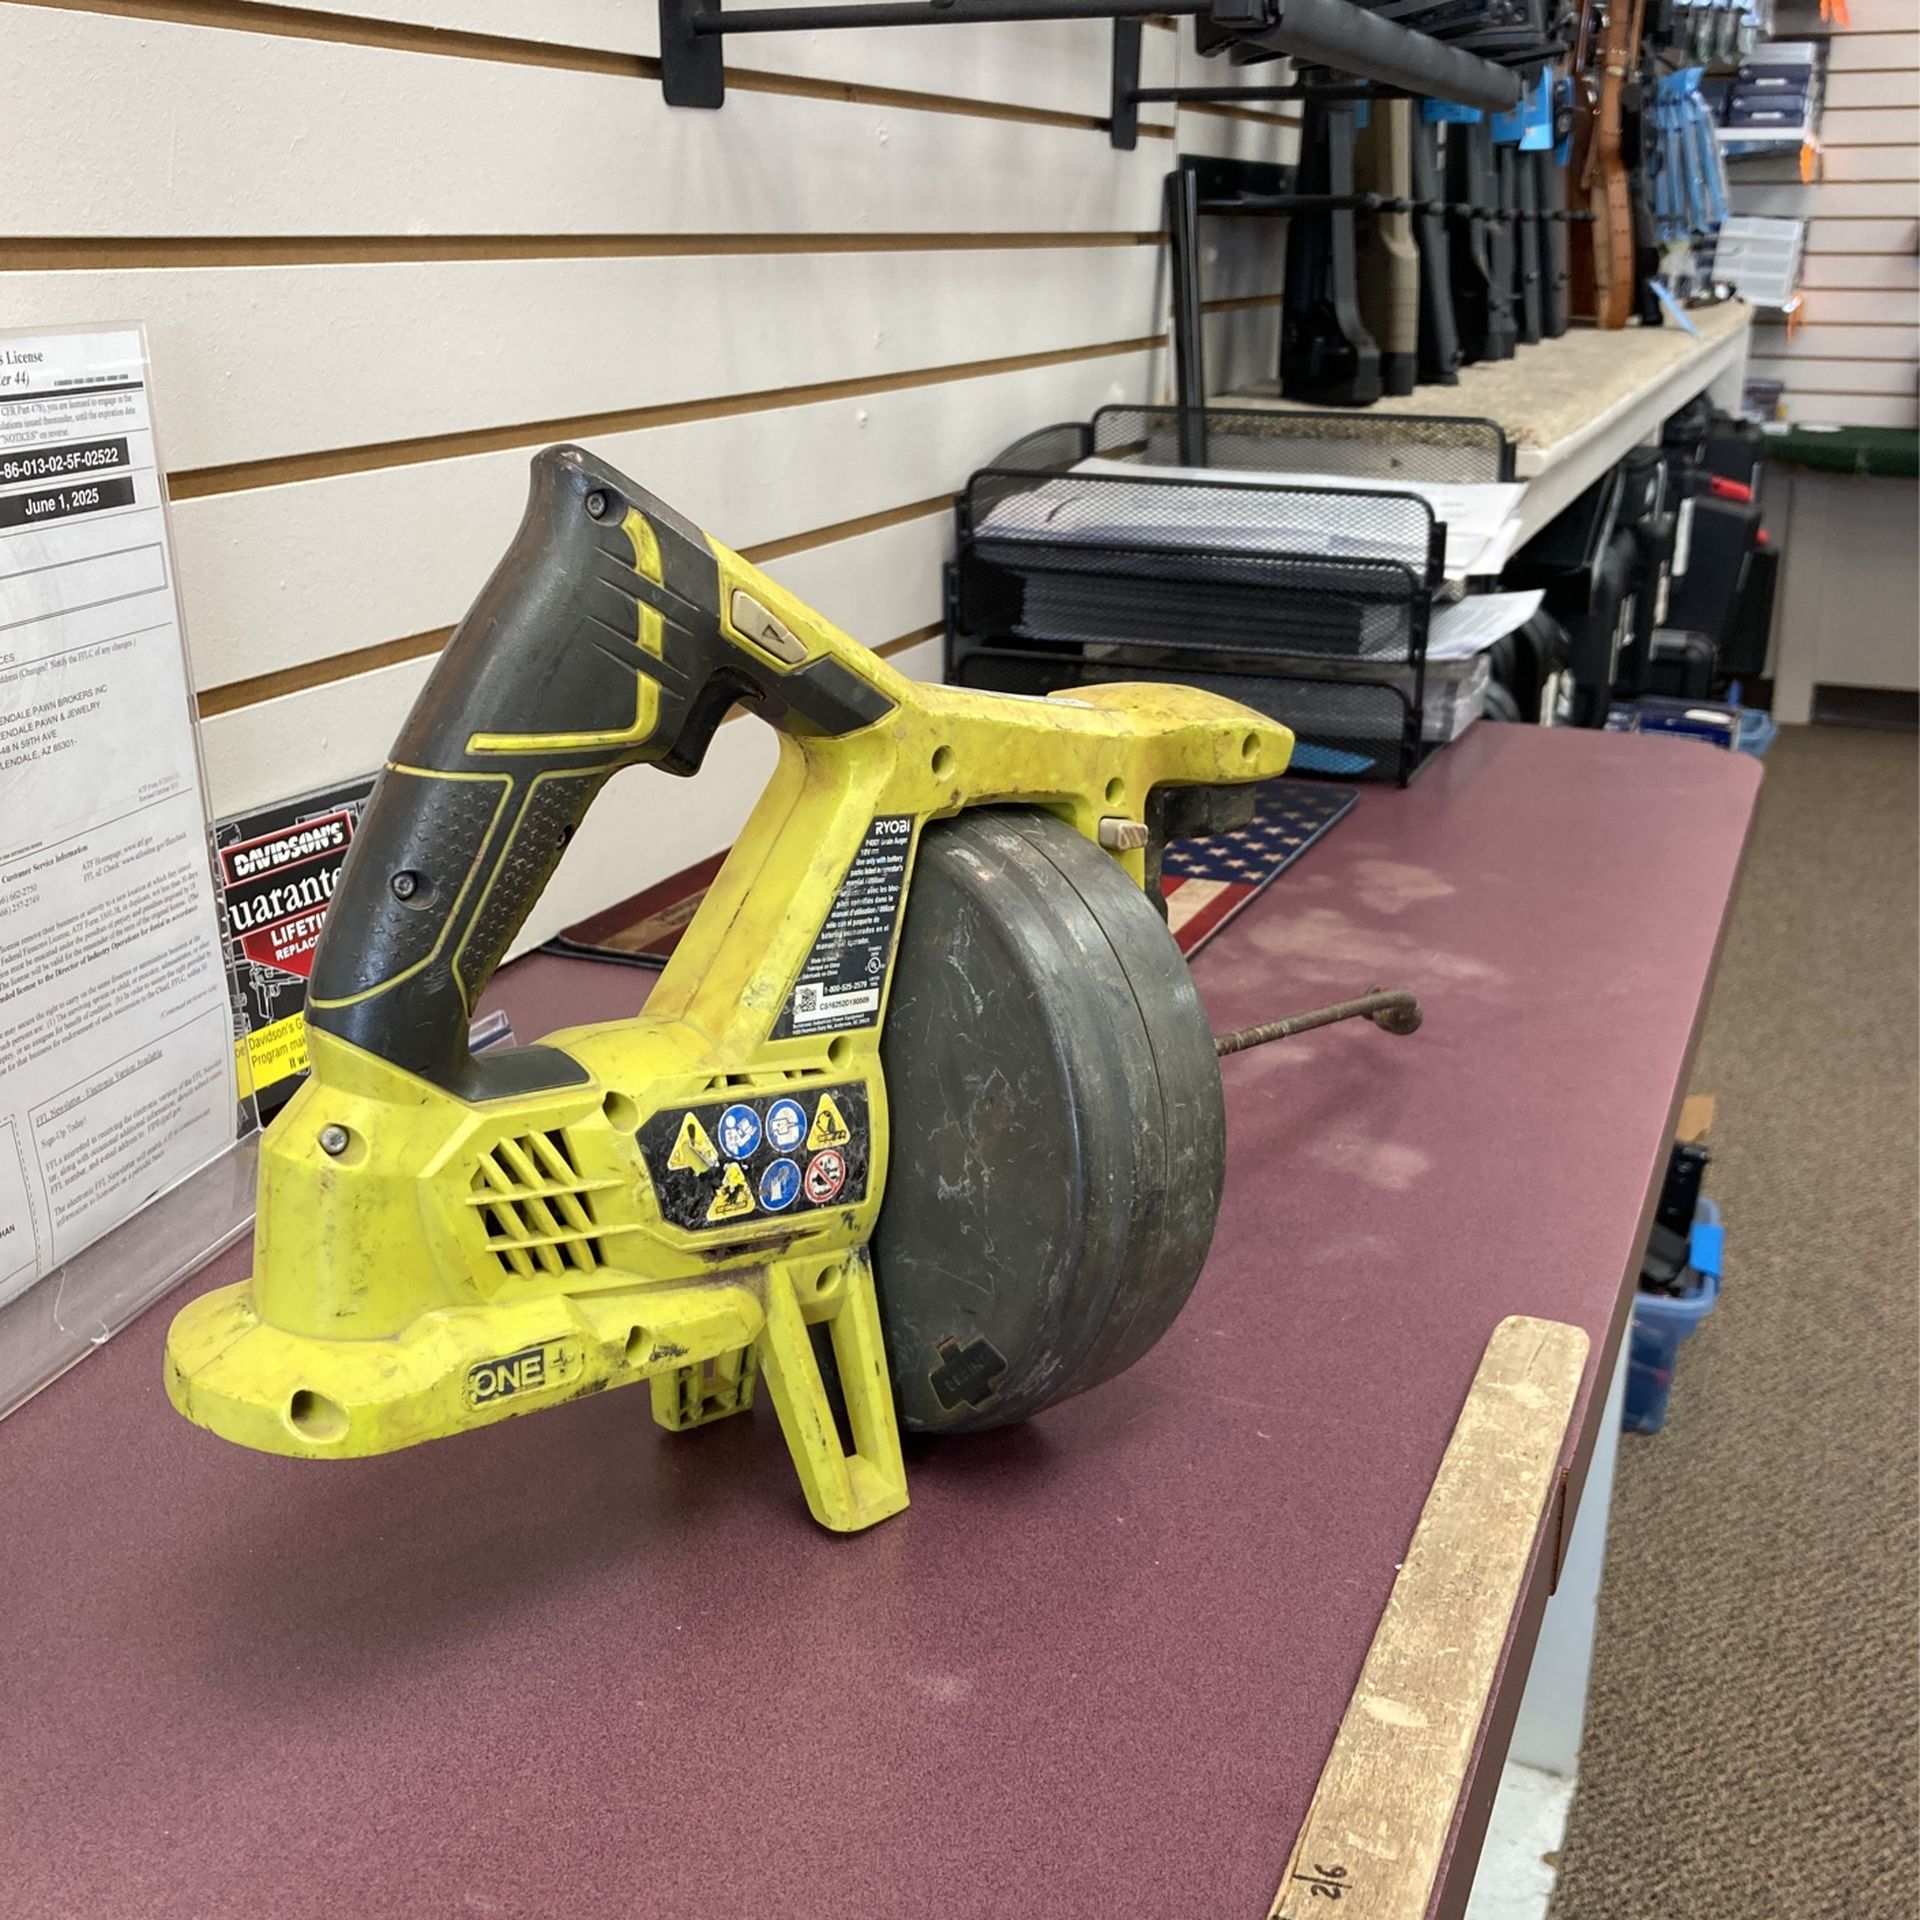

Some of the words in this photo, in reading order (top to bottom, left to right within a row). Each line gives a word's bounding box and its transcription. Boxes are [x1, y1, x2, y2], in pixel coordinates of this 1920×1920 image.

[6, 350, 43, 365] License
[14, 370, 29, 388] 44)
[25, 498, 56, 515] June
[58, 493, 71, 512] 1,
[71, 488, 100, 508] 2025
[32, 700, 57, 715] PAWN
[57, 688, 93, 708] BROKERS
[94, 684, 108, 695] INC
[35, 715, 59, 729] PAWN
[60, 712, 66, 722] &
[67, 700, 101, 719] JEWELRY
[12, 742, 20, 751] N
[20, 735, 41, 749] 59TH
[41, 729, 58, 742] AVE
[41, 744, 52, 756] AZ
[875, 819, 910, 835] RYOBI
[234, 823, 343, 877] DAVIDSON'S
[1, 868, 32, 884] Customer
[32, 858, 55, 871] Service
[55, 845, 89, 863] Information
[217, 867, 343, 937] uarant
[16, 981, 36, 996] license
[44, 973, 54, 982] the
[55, 960, 79, 978] Director
[87, 947, 110, 963] Industry
[111, 931, 140, 950] Operations
[140, 927, 149, 937] for
[149, 918, 165, 932] denial
[248, 1023, 295, 1051] Davidson's
[251, 1044, 289, 1069] Program
